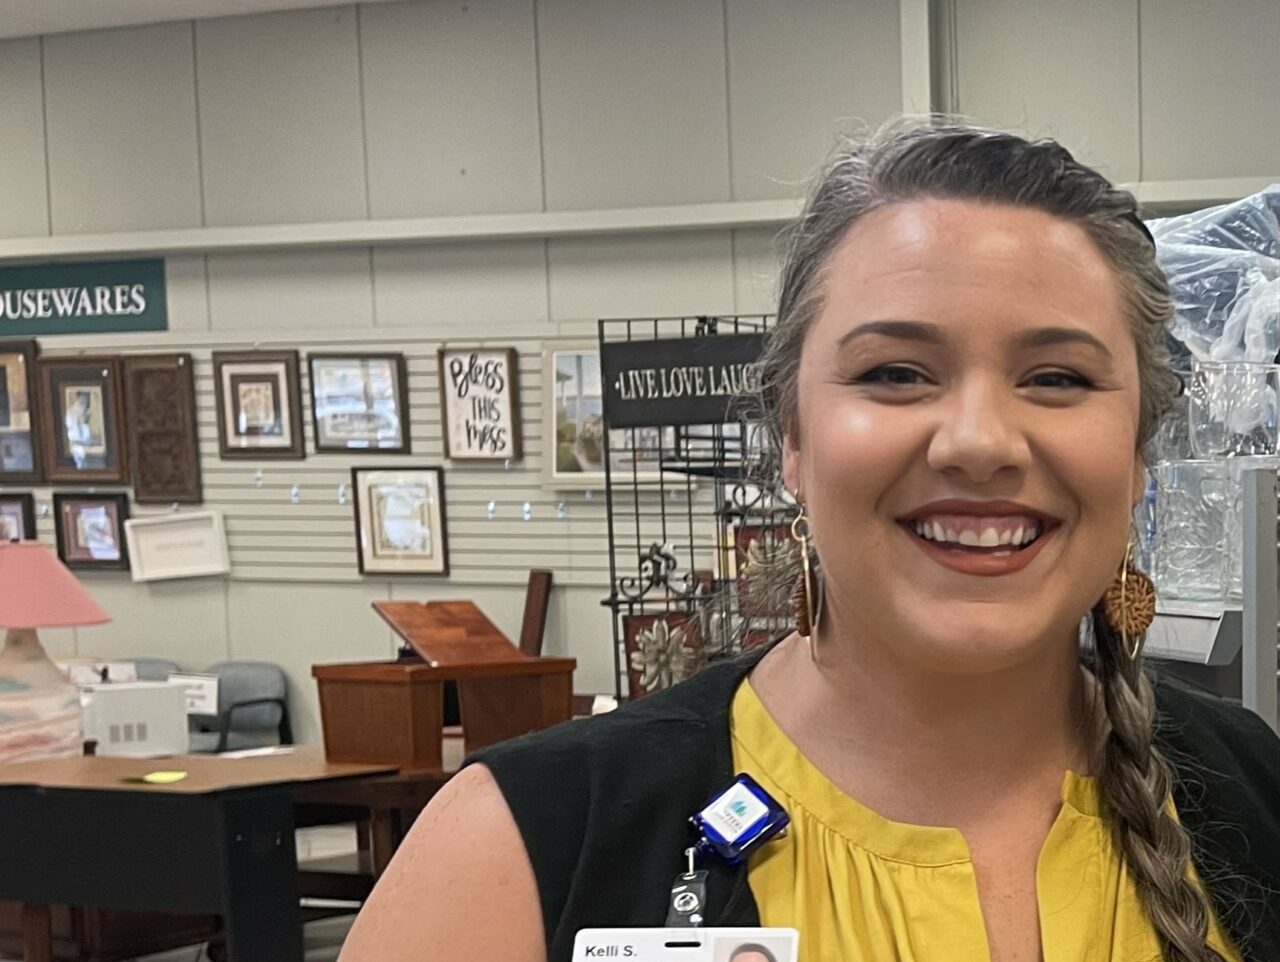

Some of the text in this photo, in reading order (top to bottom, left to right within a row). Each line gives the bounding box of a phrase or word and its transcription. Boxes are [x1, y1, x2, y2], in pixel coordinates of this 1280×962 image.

[0, 284, 146, 319] USEWARES
[450, 353, 505, 398] Bless
[618, 363, 761, 400] LIVE LOVE LAUG
[471, 396, 501, 422] THIS
[585, 945, 638, 957] Kelli S.
